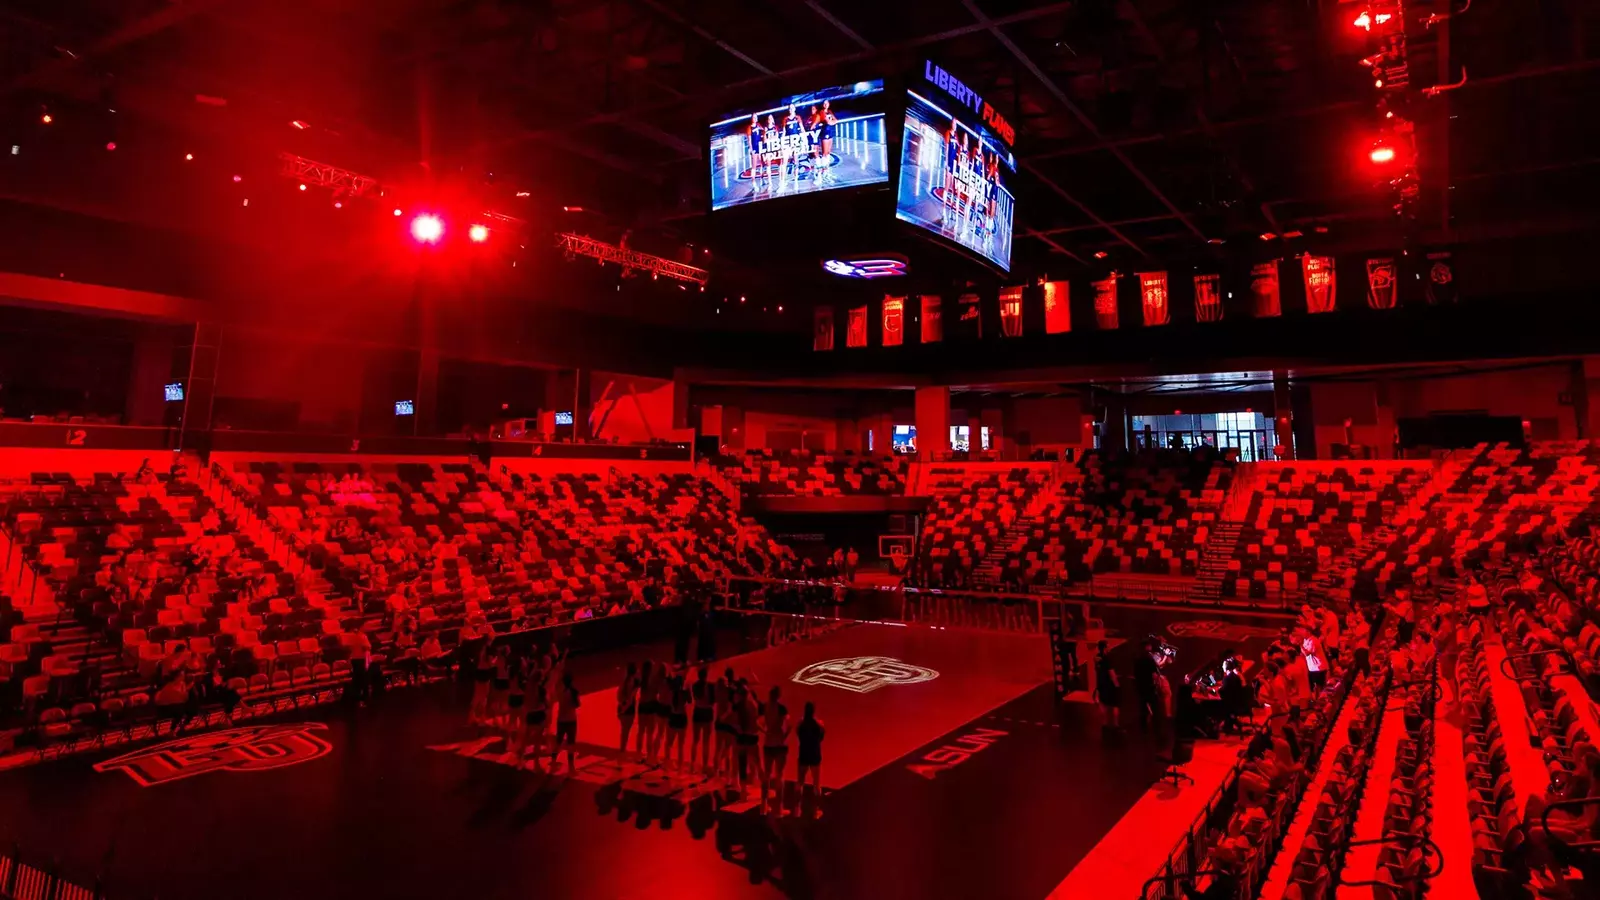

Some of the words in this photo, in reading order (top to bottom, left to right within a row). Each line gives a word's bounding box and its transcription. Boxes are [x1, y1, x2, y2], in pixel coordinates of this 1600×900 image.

[925, 60, 982, 114] LIBERTY
[759, 129, 821, 154] LIBERTY
[953, 159, 993, 199] LIBERTY
[905, 727, 1010, 780] ASUN
